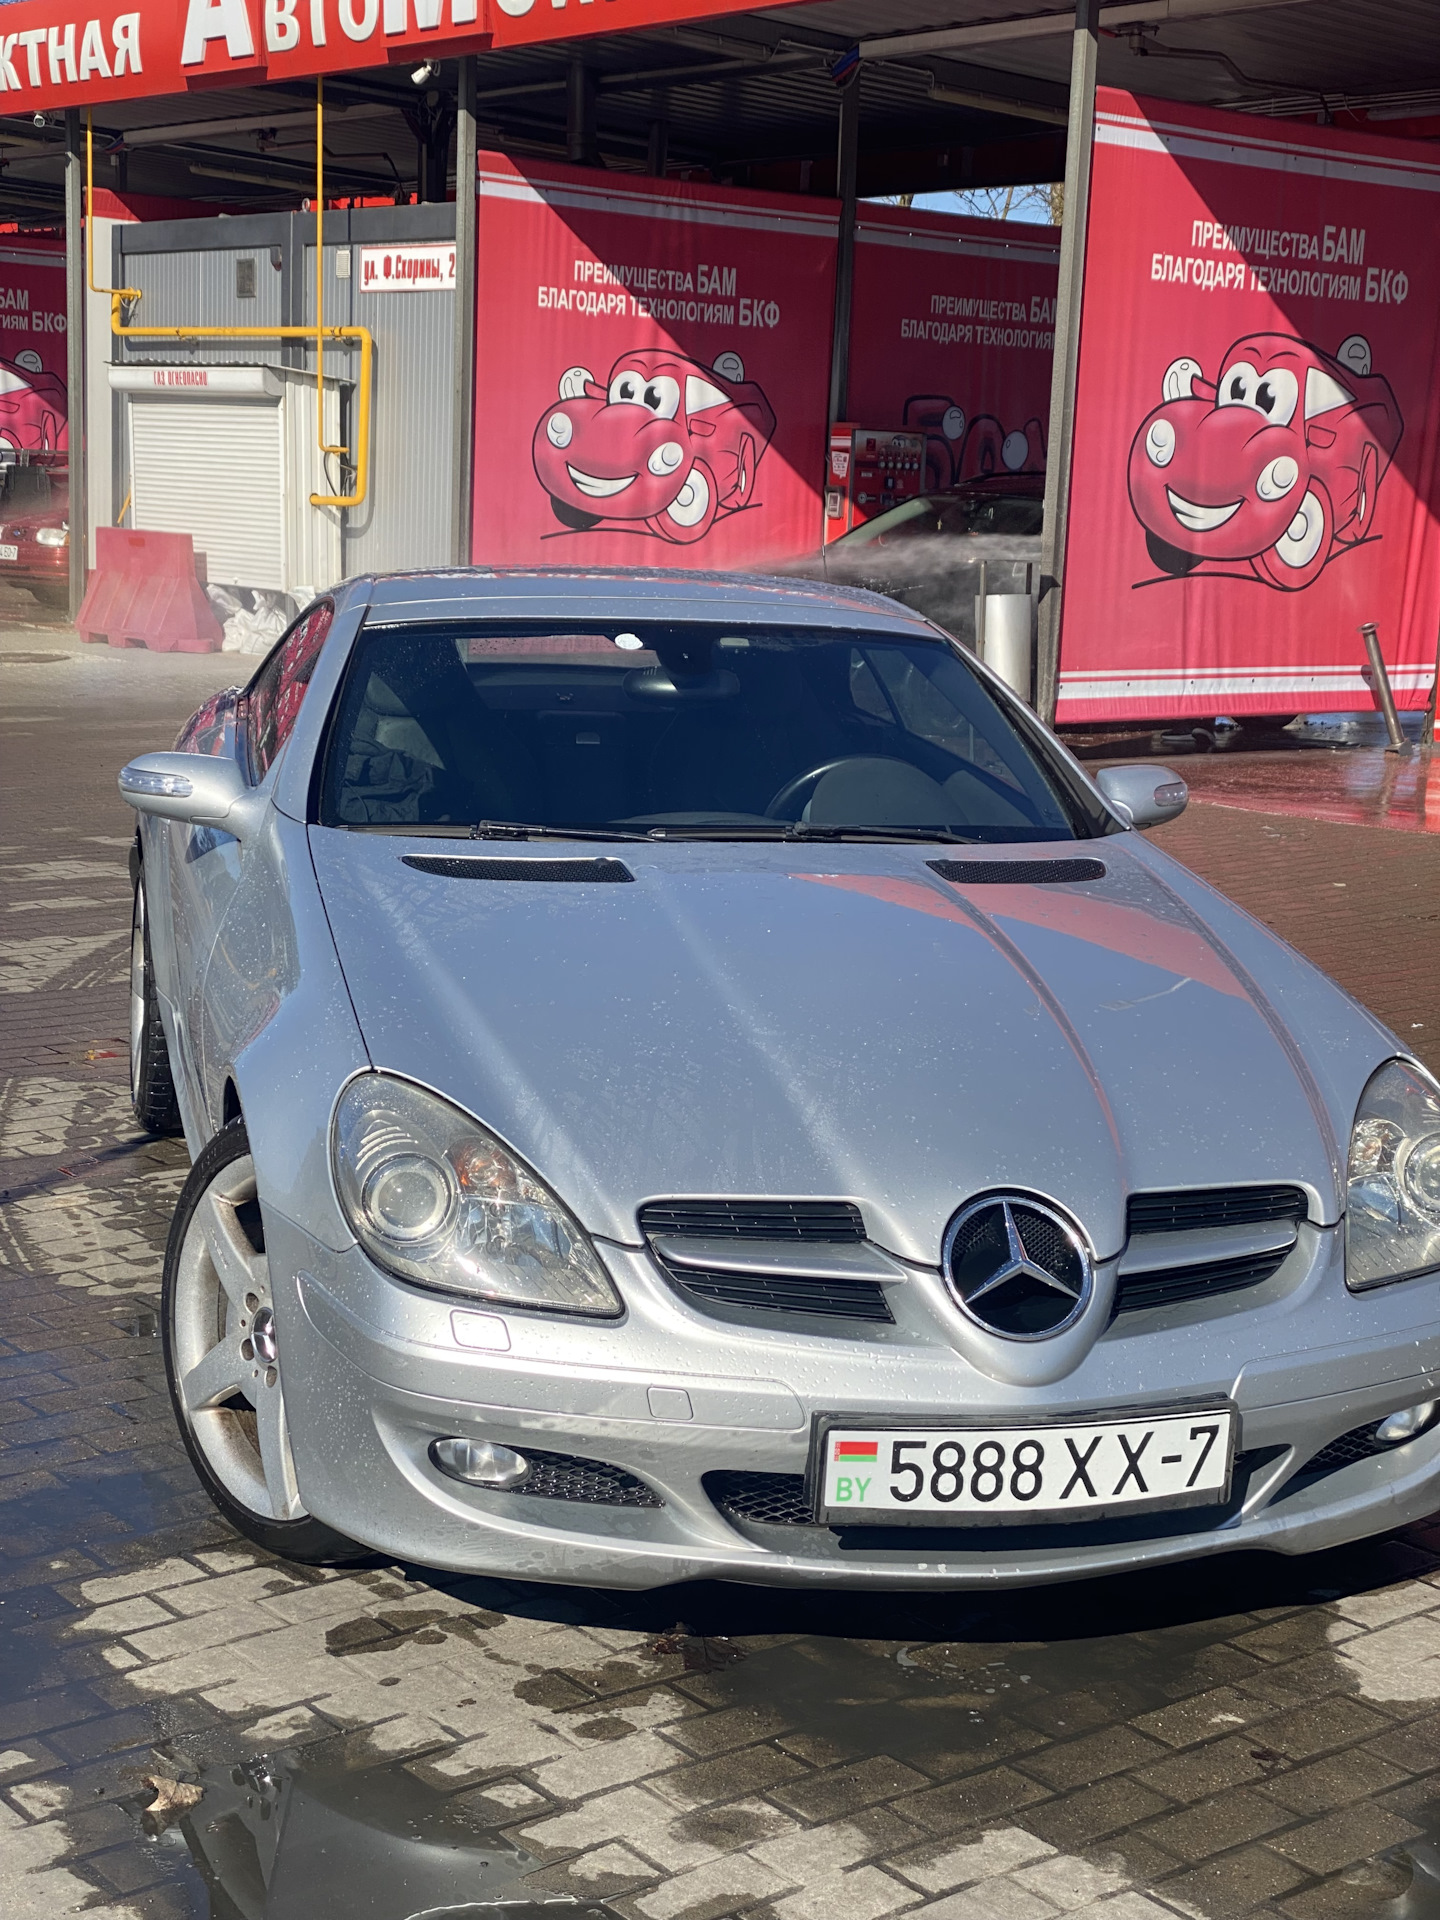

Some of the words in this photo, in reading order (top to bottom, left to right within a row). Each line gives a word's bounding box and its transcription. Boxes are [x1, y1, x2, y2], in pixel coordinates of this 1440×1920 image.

[1191, 220, 1319, 260] ПРЕИМУЩЕСТВА
[1322, 225, 1366, 265] БАМ
[364, 260, 379, 286] ул.
[574, 260, 694, 292] ПРЕИМУЩЕСТВА
[697, 264, 737, 297] БАМ
[1151, 253, 1246, 291] БЛАГОДАРЯ
[1249, 266, 1361, 301] ТЕХНОЛОГИЯМ
[1364, 267, 1409, 304] БКФ
[538, 286, 626, 316] БЛАГОДАРЯ
[630, 295, 735, 325] ТЕХНОЛОГИЯМ
[739, 298, 780, 328] БКФ
[930, 295, 1027, 322] ПРЕИМУЩЕСТВА
[32, 311, 67, 333] БКФ
[901, 318, 973, 345] БЛАГОДАРЯ
[153, 370, 166, 386] ГАЗ
[167, 370, 208, 386] ОГНЕОПАСНО
[890, 1439, 1045, 1503] 5888
[835, 1477, 872, 1502] BY
